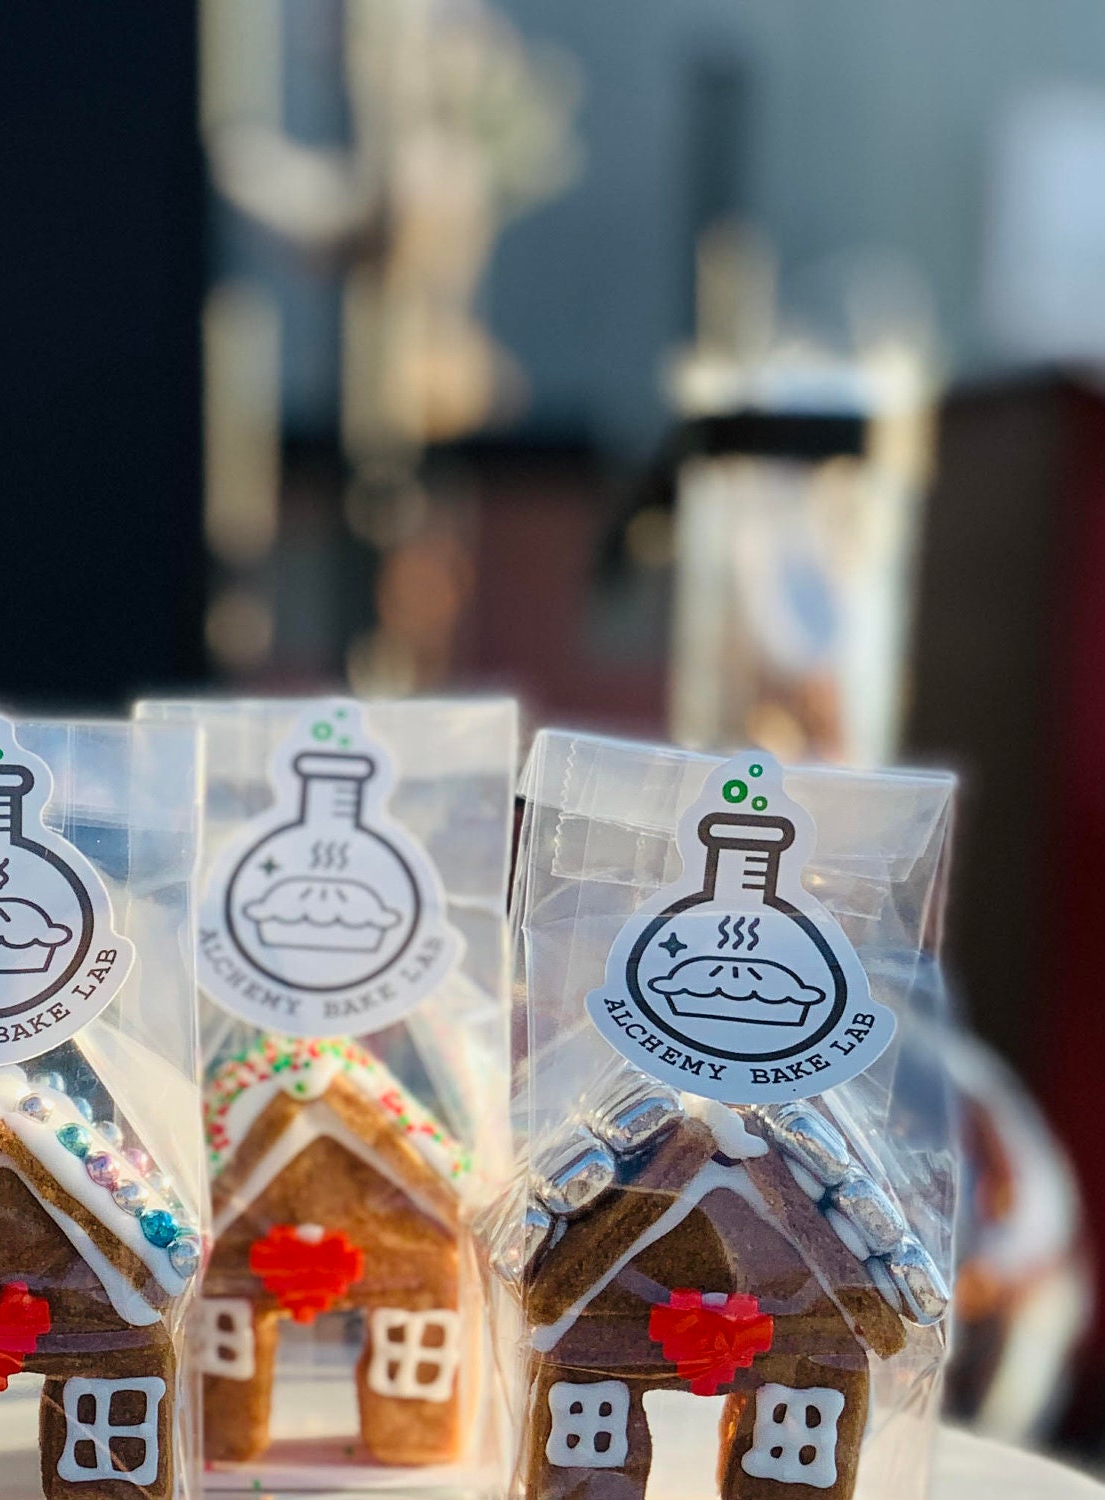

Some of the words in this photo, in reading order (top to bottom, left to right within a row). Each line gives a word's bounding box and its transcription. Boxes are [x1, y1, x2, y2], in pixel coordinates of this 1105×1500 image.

[72, 948, 117, 1000] LAB
[199, 928, 301, 1016] ALCHEMY
[323, 982, 398, 1018] BAKE
[400, 937, 441, 983] LAB
[604, 998, 727, 1081] ALCHEMY
[750, 1053, 831, 1084] BAKE
[830, 1012, 876, 1056] LAB
